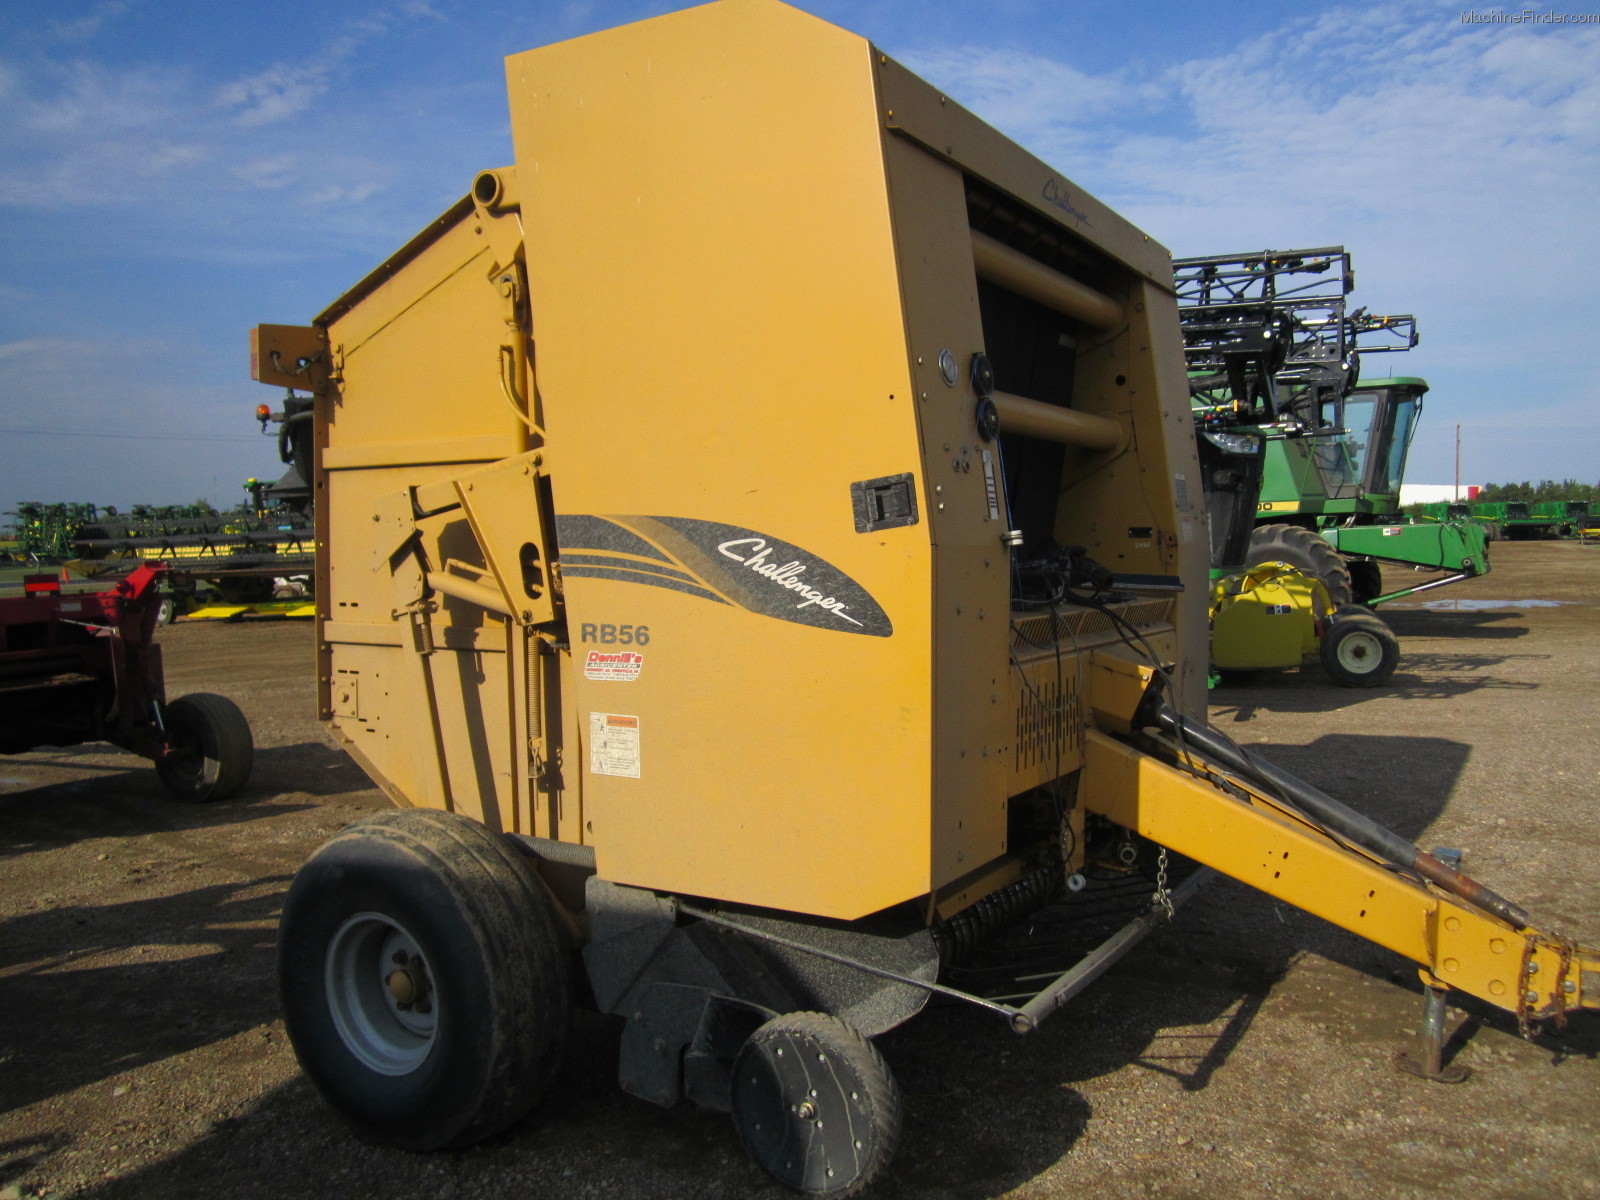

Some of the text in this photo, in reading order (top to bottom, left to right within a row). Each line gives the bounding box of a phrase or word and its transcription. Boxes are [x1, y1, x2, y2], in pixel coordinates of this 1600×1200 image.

[1042, 178, 1094, 228] Challenger
[717, 537, 864, 626] Challenger
[581, 622, 650, 646] RB56
